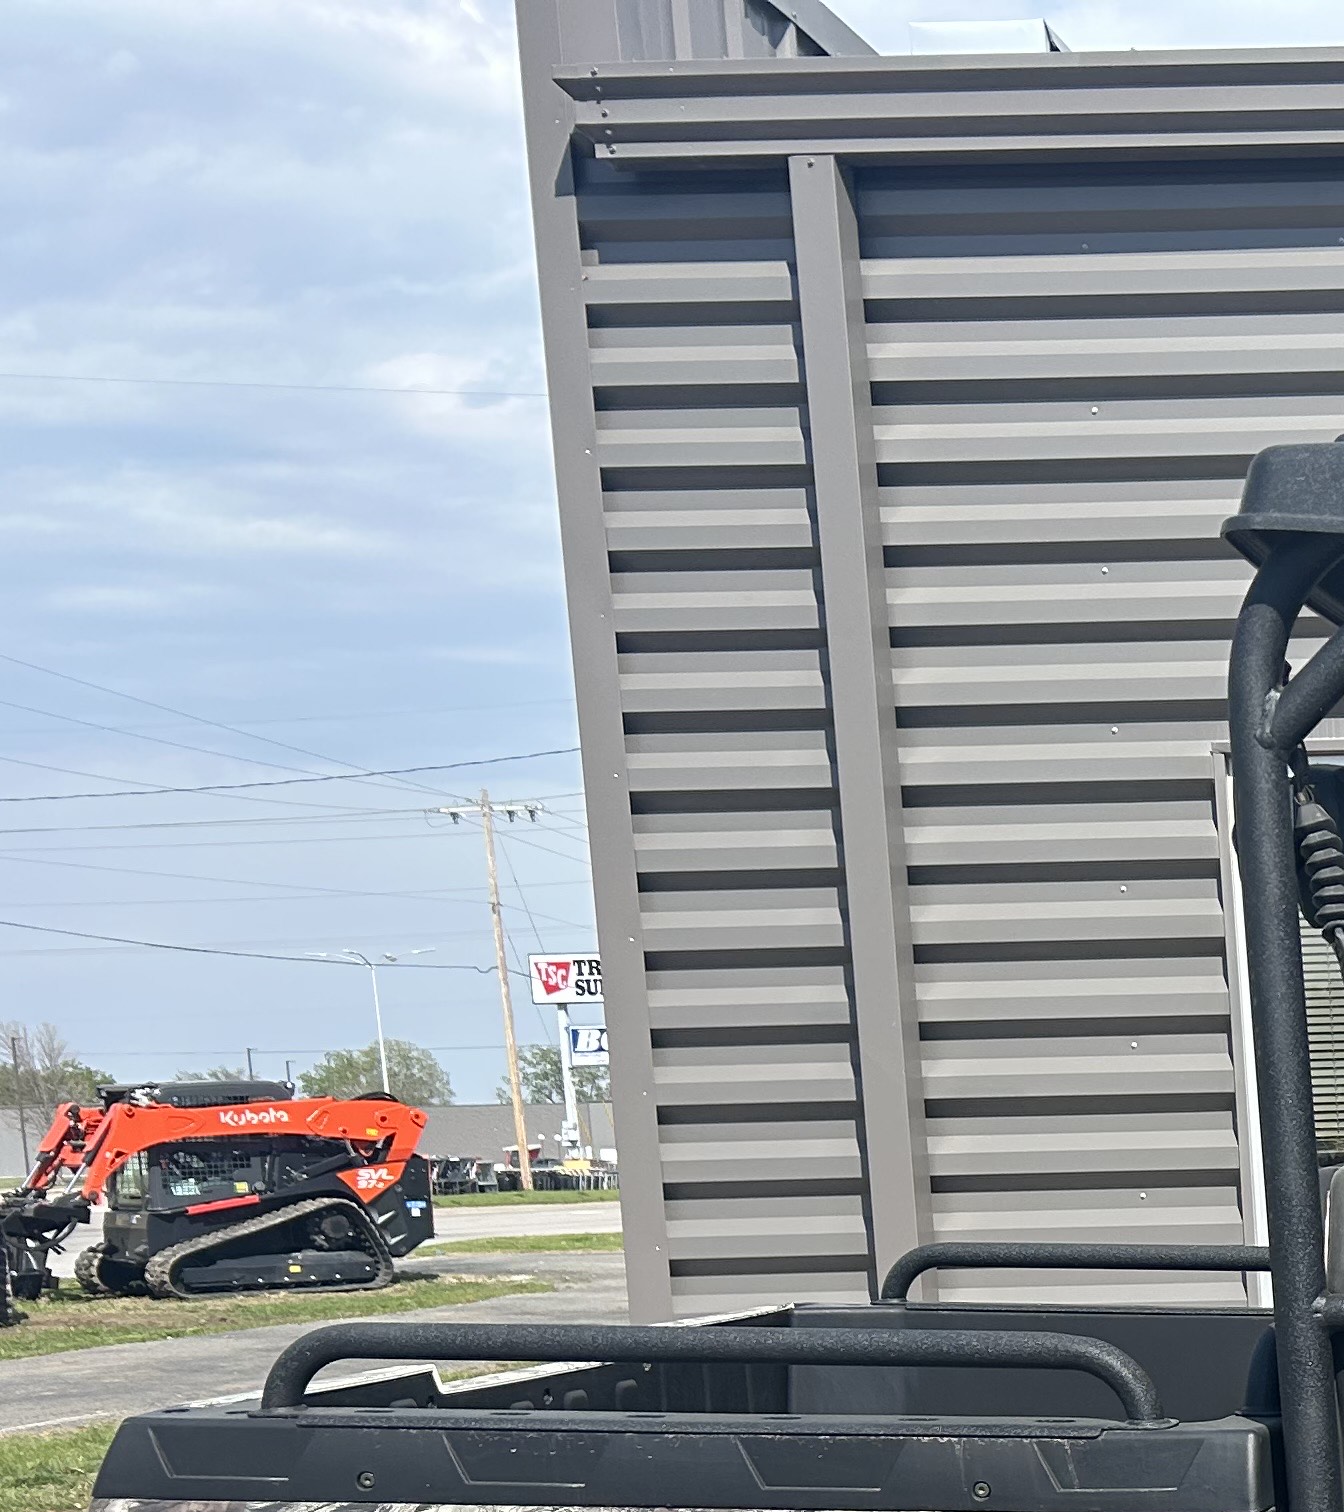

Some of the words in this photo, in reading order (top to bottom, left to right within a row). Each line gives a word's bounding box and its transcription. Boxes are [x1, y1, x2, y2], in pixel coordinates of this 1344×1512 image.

[537, 962, 568, 989] TSC
[219, 1107, 289, 1127] Kubota
[356, 1168, 395, 1180] SVL
